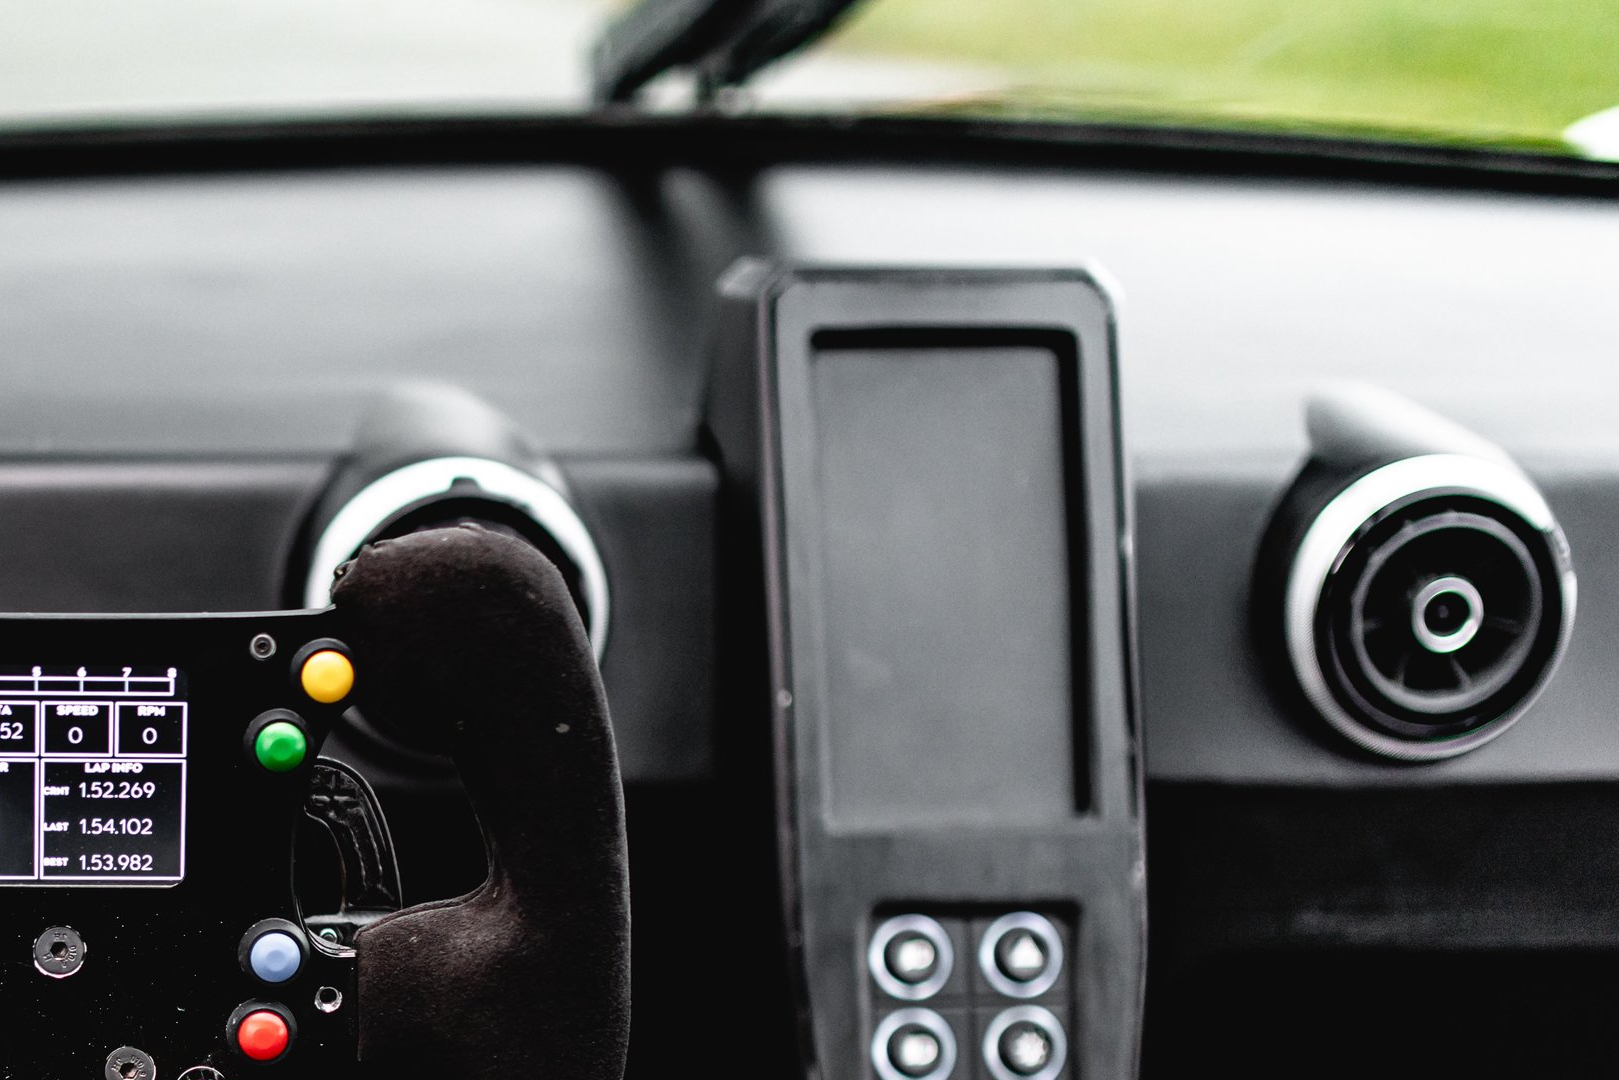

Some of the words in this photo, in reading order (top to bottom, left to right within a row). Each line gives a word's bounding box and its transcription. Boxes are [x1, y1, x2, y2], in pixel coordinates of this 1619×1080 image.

[31, 666, 42, 677] 5
[76, 667, 87, 678] 6
[121, 667, 132, 678] 7
[166, 668, 177, 679] 8
[57, 705, 98, 716] SPEED
[138, 706, 165, 716] RPM
[68, 727, 83, 744] 0
[143, 728, 157, 744] 0
[85, 762, 110, 773] LAP
[112, 762, 144, 773] INFO
[79, 782, 155, 798] 1.52.269
[44, 822, 69, 831] LAST
[80, 818, 152, 835] 1.54.102
[79, 854, 153, 871] 1.53.982
